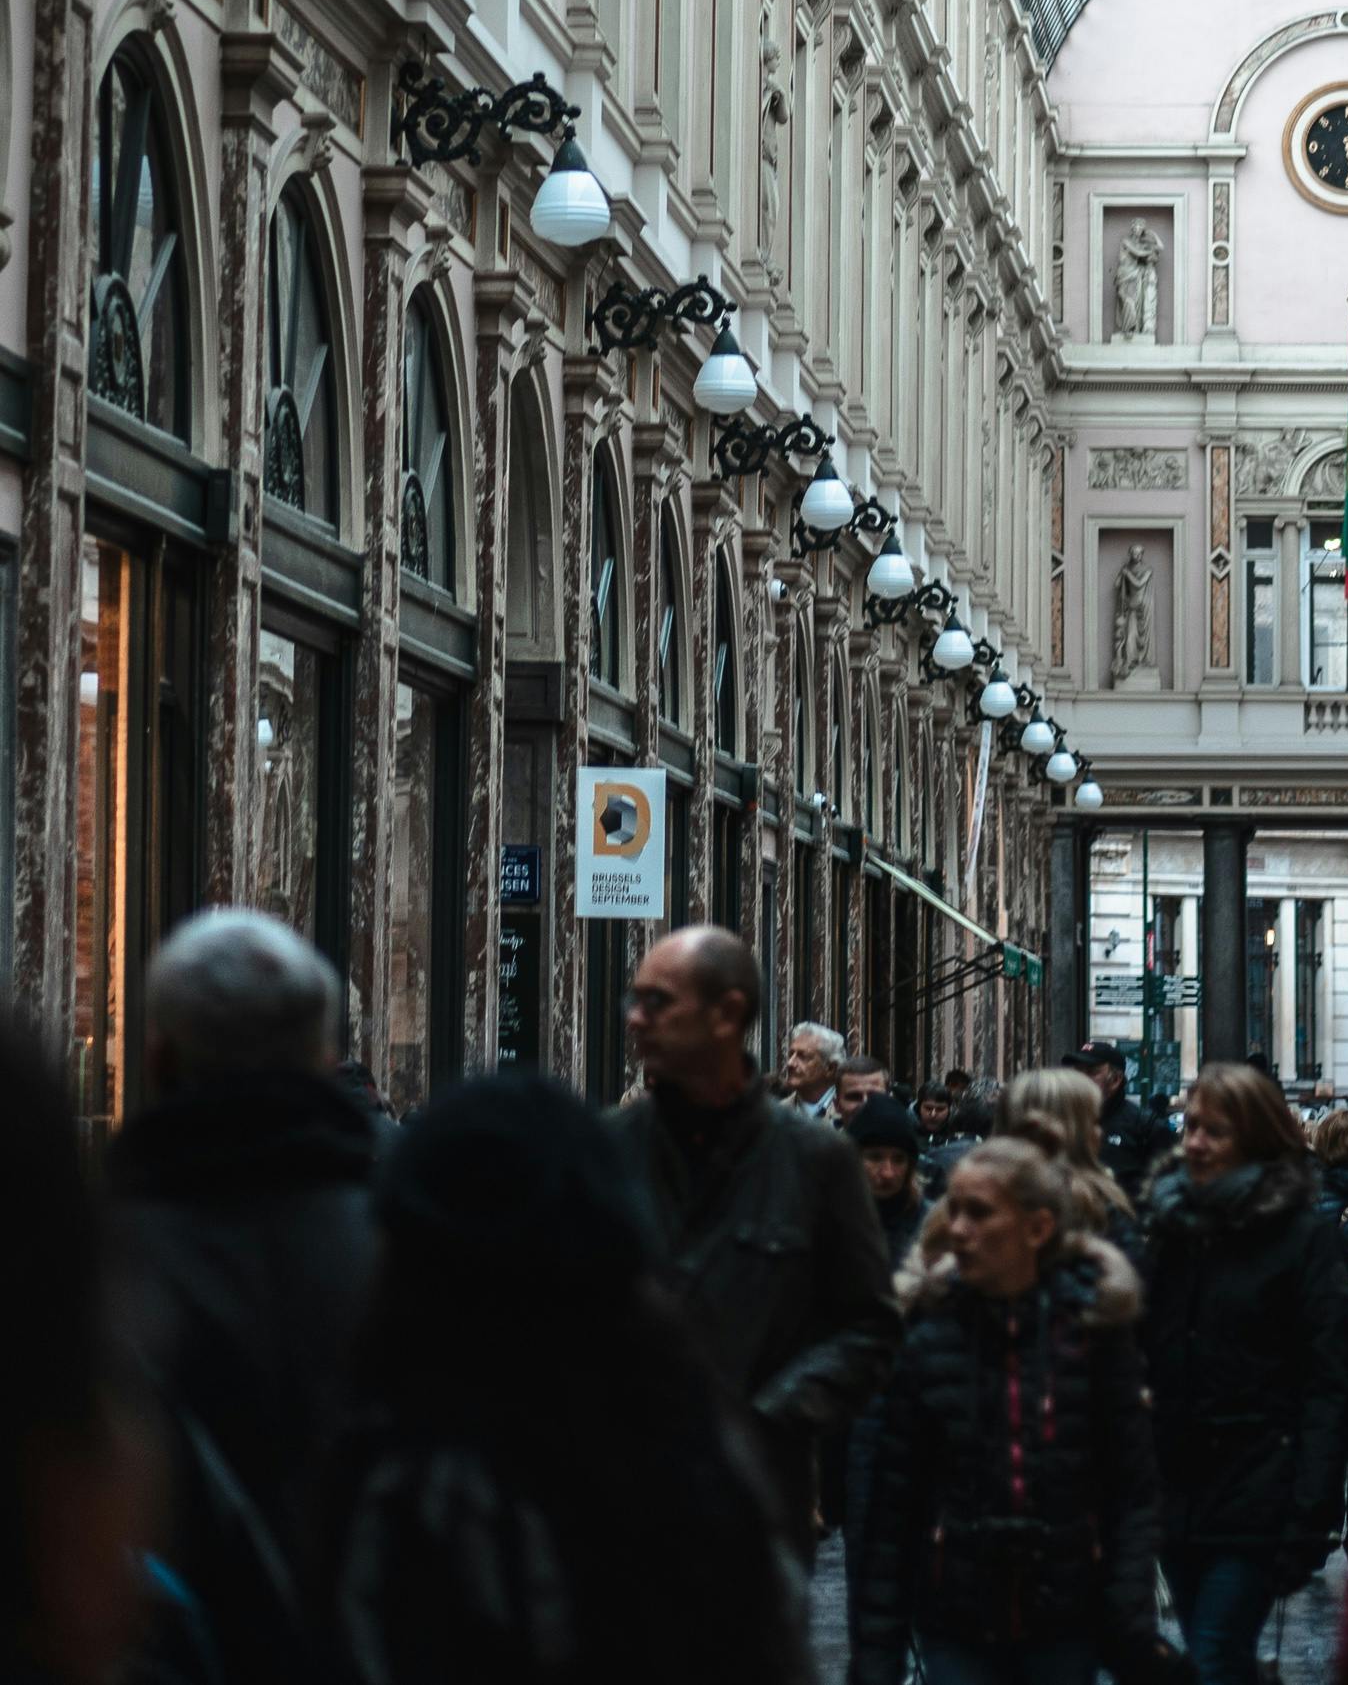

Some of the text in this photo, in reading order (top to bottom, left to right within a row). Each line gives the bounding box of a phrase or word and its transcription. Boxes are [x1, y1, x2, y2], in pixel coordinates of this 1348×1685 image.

[592, 872, 642, 884] BRUSSELS
[592, 883, 630, 894] DESIGN
[591, 893, 650, 906] SEPTEMBER
